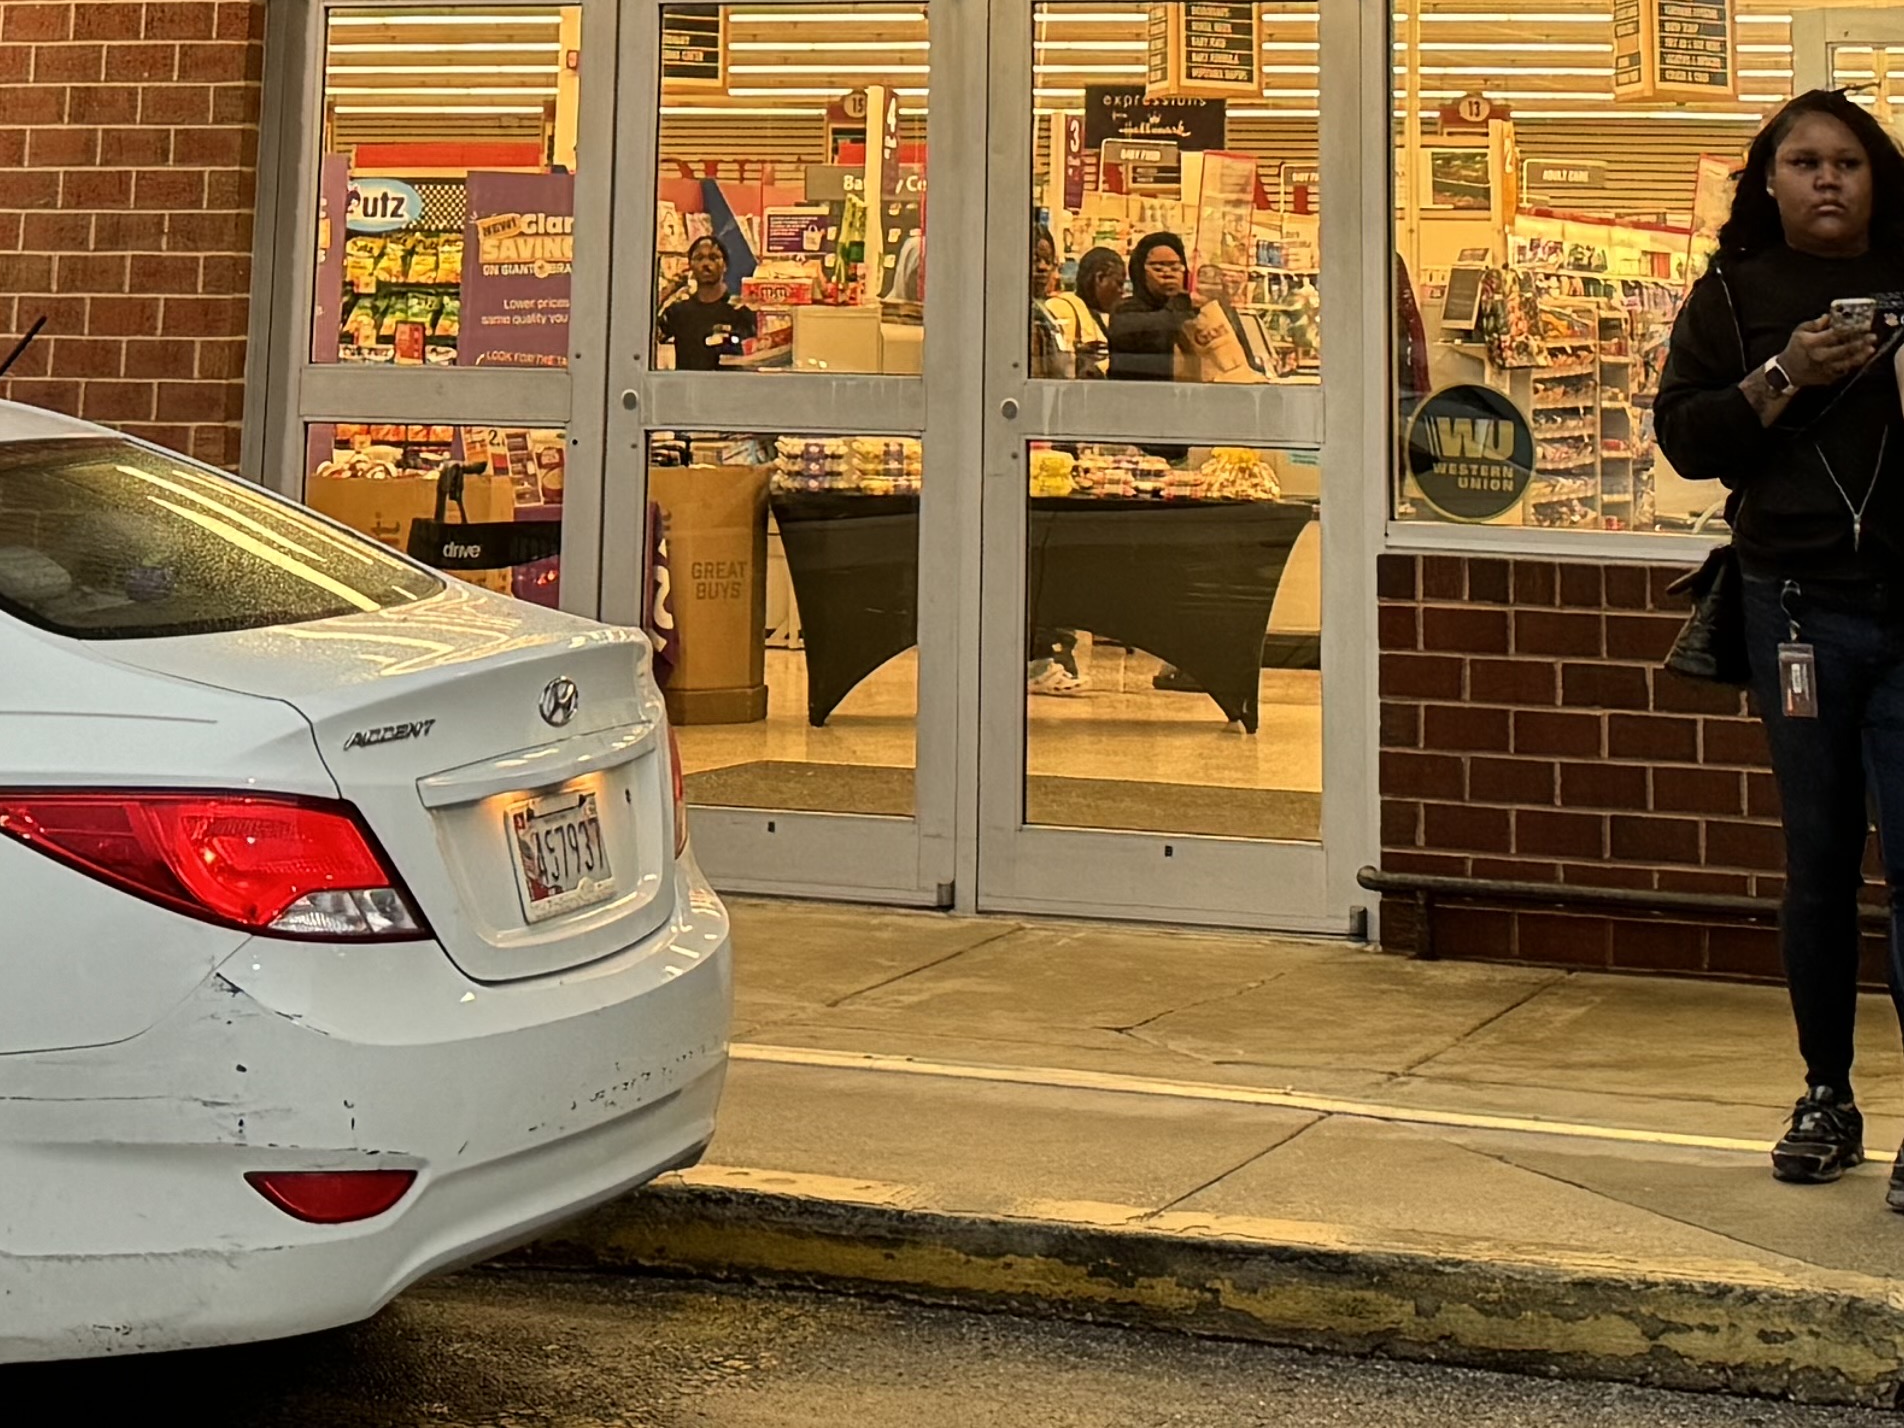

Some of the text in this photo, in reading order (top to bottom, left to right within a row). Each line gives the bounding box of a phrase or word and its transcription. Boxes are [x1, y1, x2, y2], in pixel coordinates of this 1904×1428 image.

[1468, 100, 1480, 117] 13
[1069, 119, 1080, 153] 3
[1434, 416, 1515, 461] WU
[1433, 462, 1515, 478] WESTERN
[1458, 477, 1515, 492] UNION
[442, 541, 482, 559] drive
[691, 561, 748, 580] GREAT
[695, 582, 742, 601] BUYS
[343, 718, 436, 752] ACCENT
